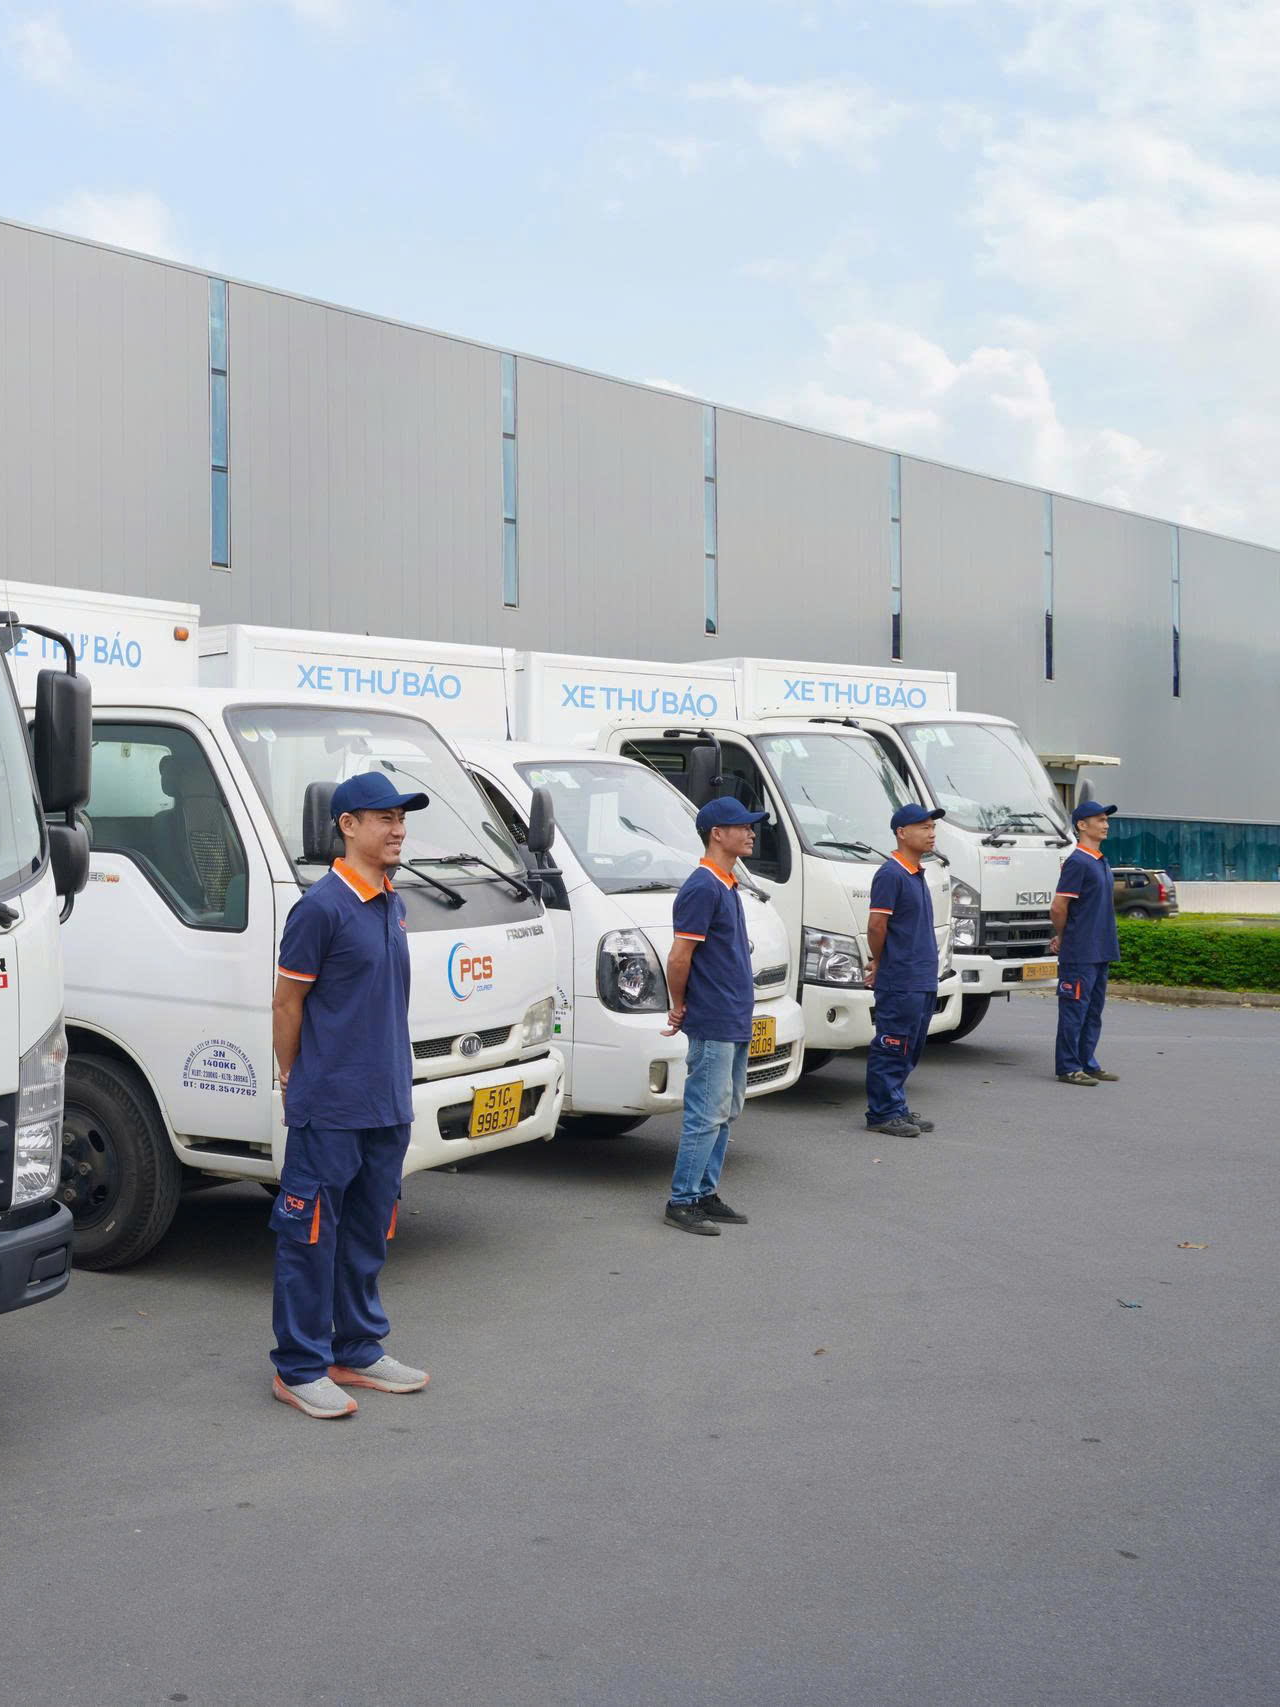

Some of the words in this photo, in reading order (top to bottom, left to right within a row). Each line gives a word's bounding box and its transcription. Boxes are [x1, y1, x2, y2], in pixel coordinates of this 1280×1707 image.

[94, 631, 142, 668] BÁO
[297, 664, 332, 690] XE
[337, 667, 400, 695] THƯ
[403, 665, 462, 699] BÁO
[562, 684, 595, 709] XE
[600, 687, 659, 713] THƯ
[662, 685, 718, 717] BÁO
[784, 679, 815, 702] XE
[818, 682, 873, 705] THƯ
[876, 680, 927, 708] BÁO
[1015, 892, 1052, 906] ISUZU
[505, 925, 545, 941] FRONTIER
[460, 956, 493, 982] PCS
[213, 1050, 226, 1058] 3N
[751, 1037, 772, 1055] 80.09
[202, 1060, 236, 1070] 1400KG
[488, 1087, 512, 1109] 51C
[477, 1106, 516, 1134] 998.37
[287, 1195, 305, 1210] PCS
